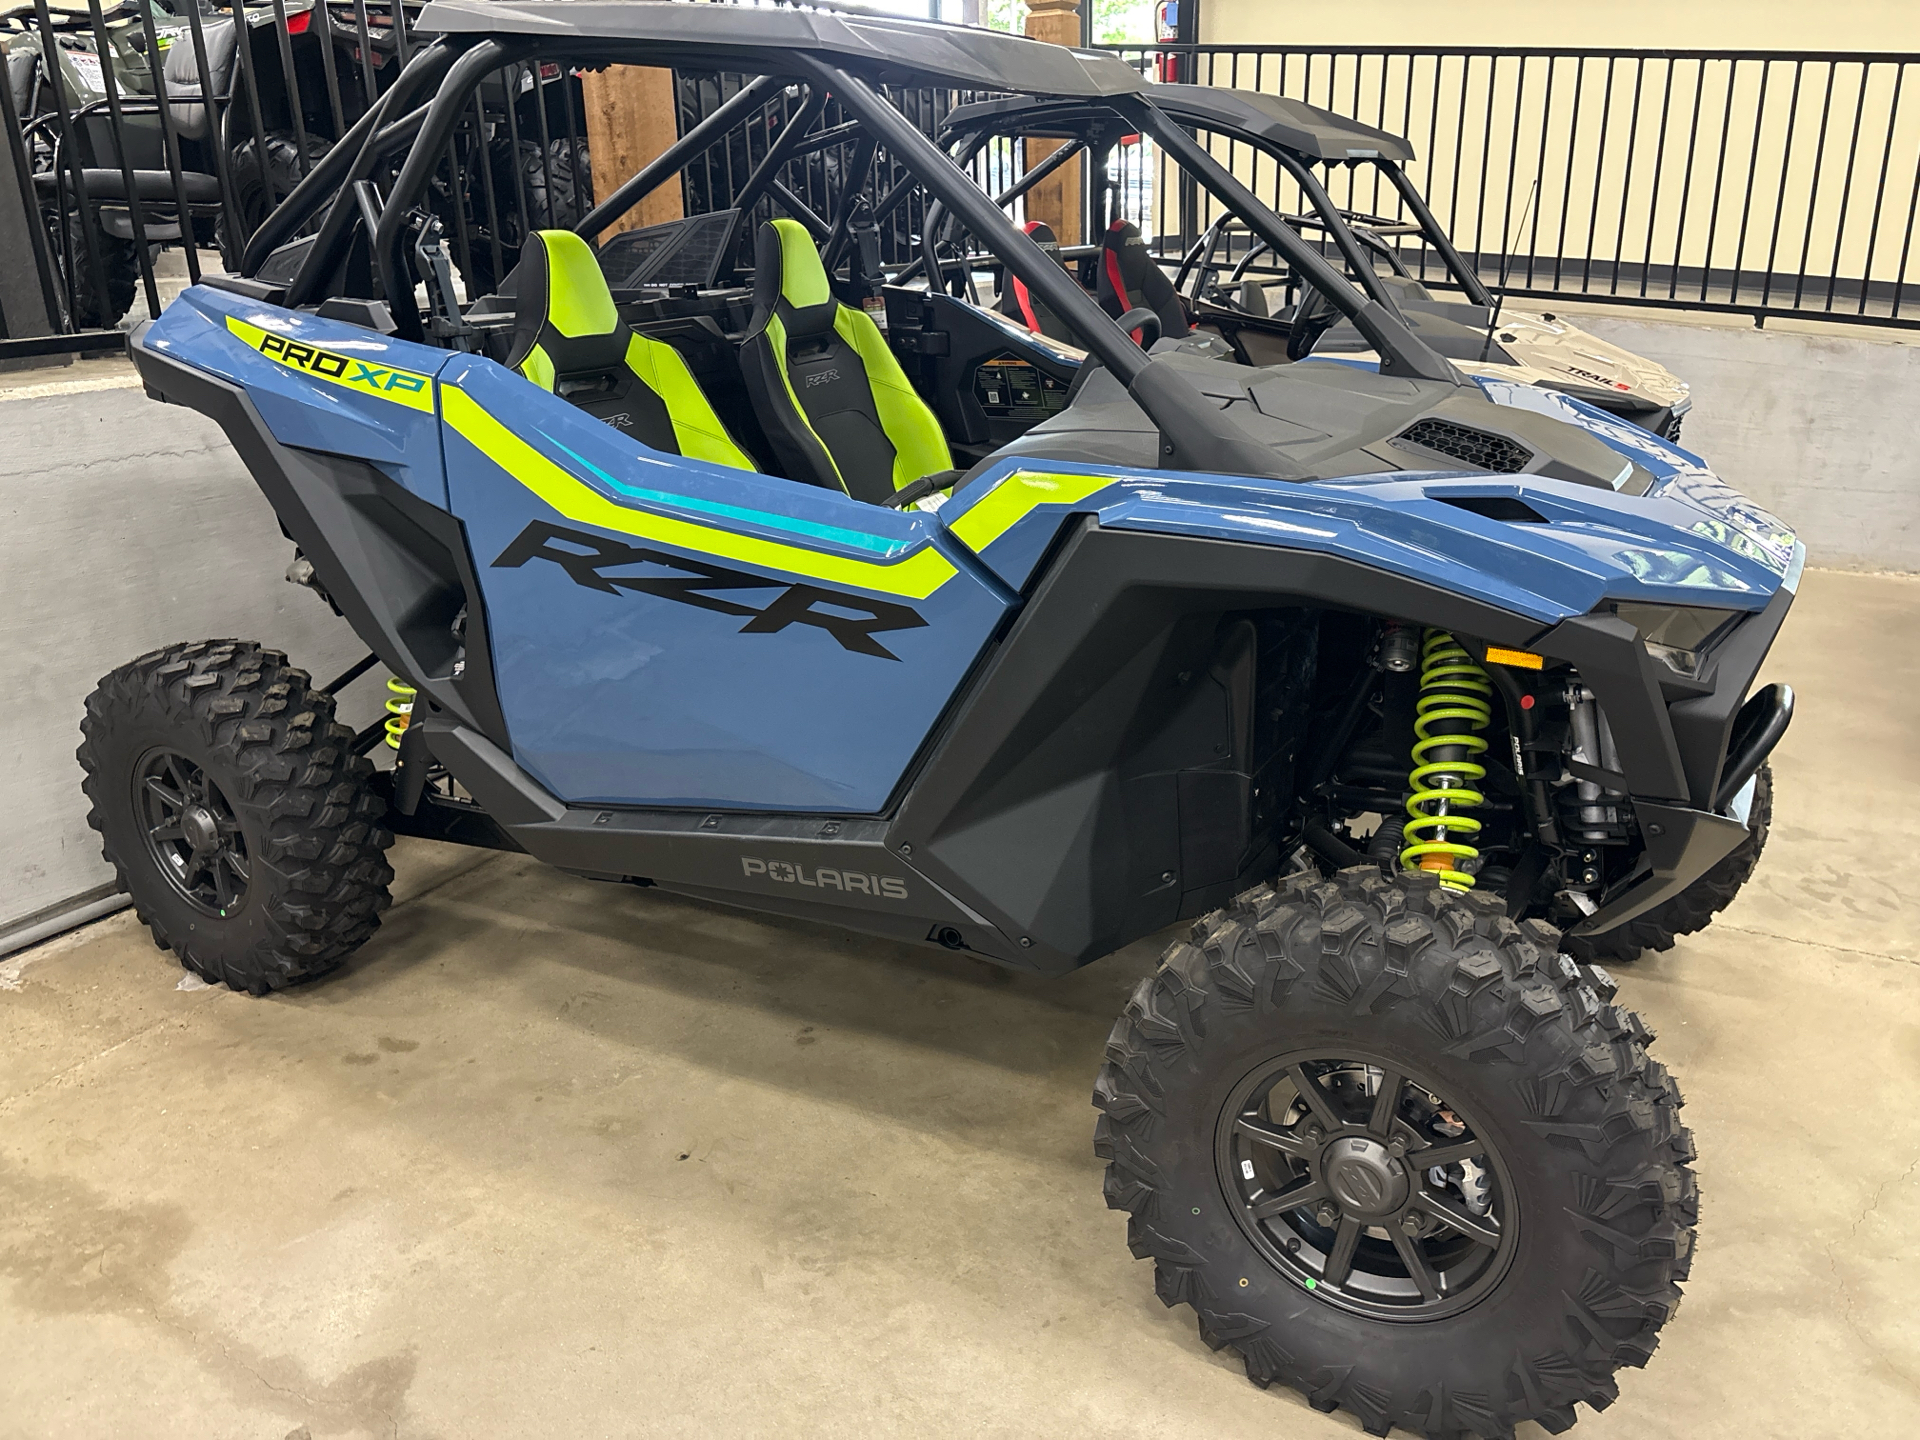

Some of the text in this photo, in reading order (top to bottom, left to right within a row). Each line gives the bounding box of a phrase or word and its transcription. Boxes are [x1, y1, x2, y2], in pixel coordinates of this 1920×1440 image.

[259, 334, 426, 393] PRO XP
[806, 368, 840, 388] RZR
[1567, 366, 1632, 391] TRAIL S
[490, 519, 930, 662] RZR
[1513, 736, 1524, 775] POLARIS
[741, 856, 908, 899] POLARIS
